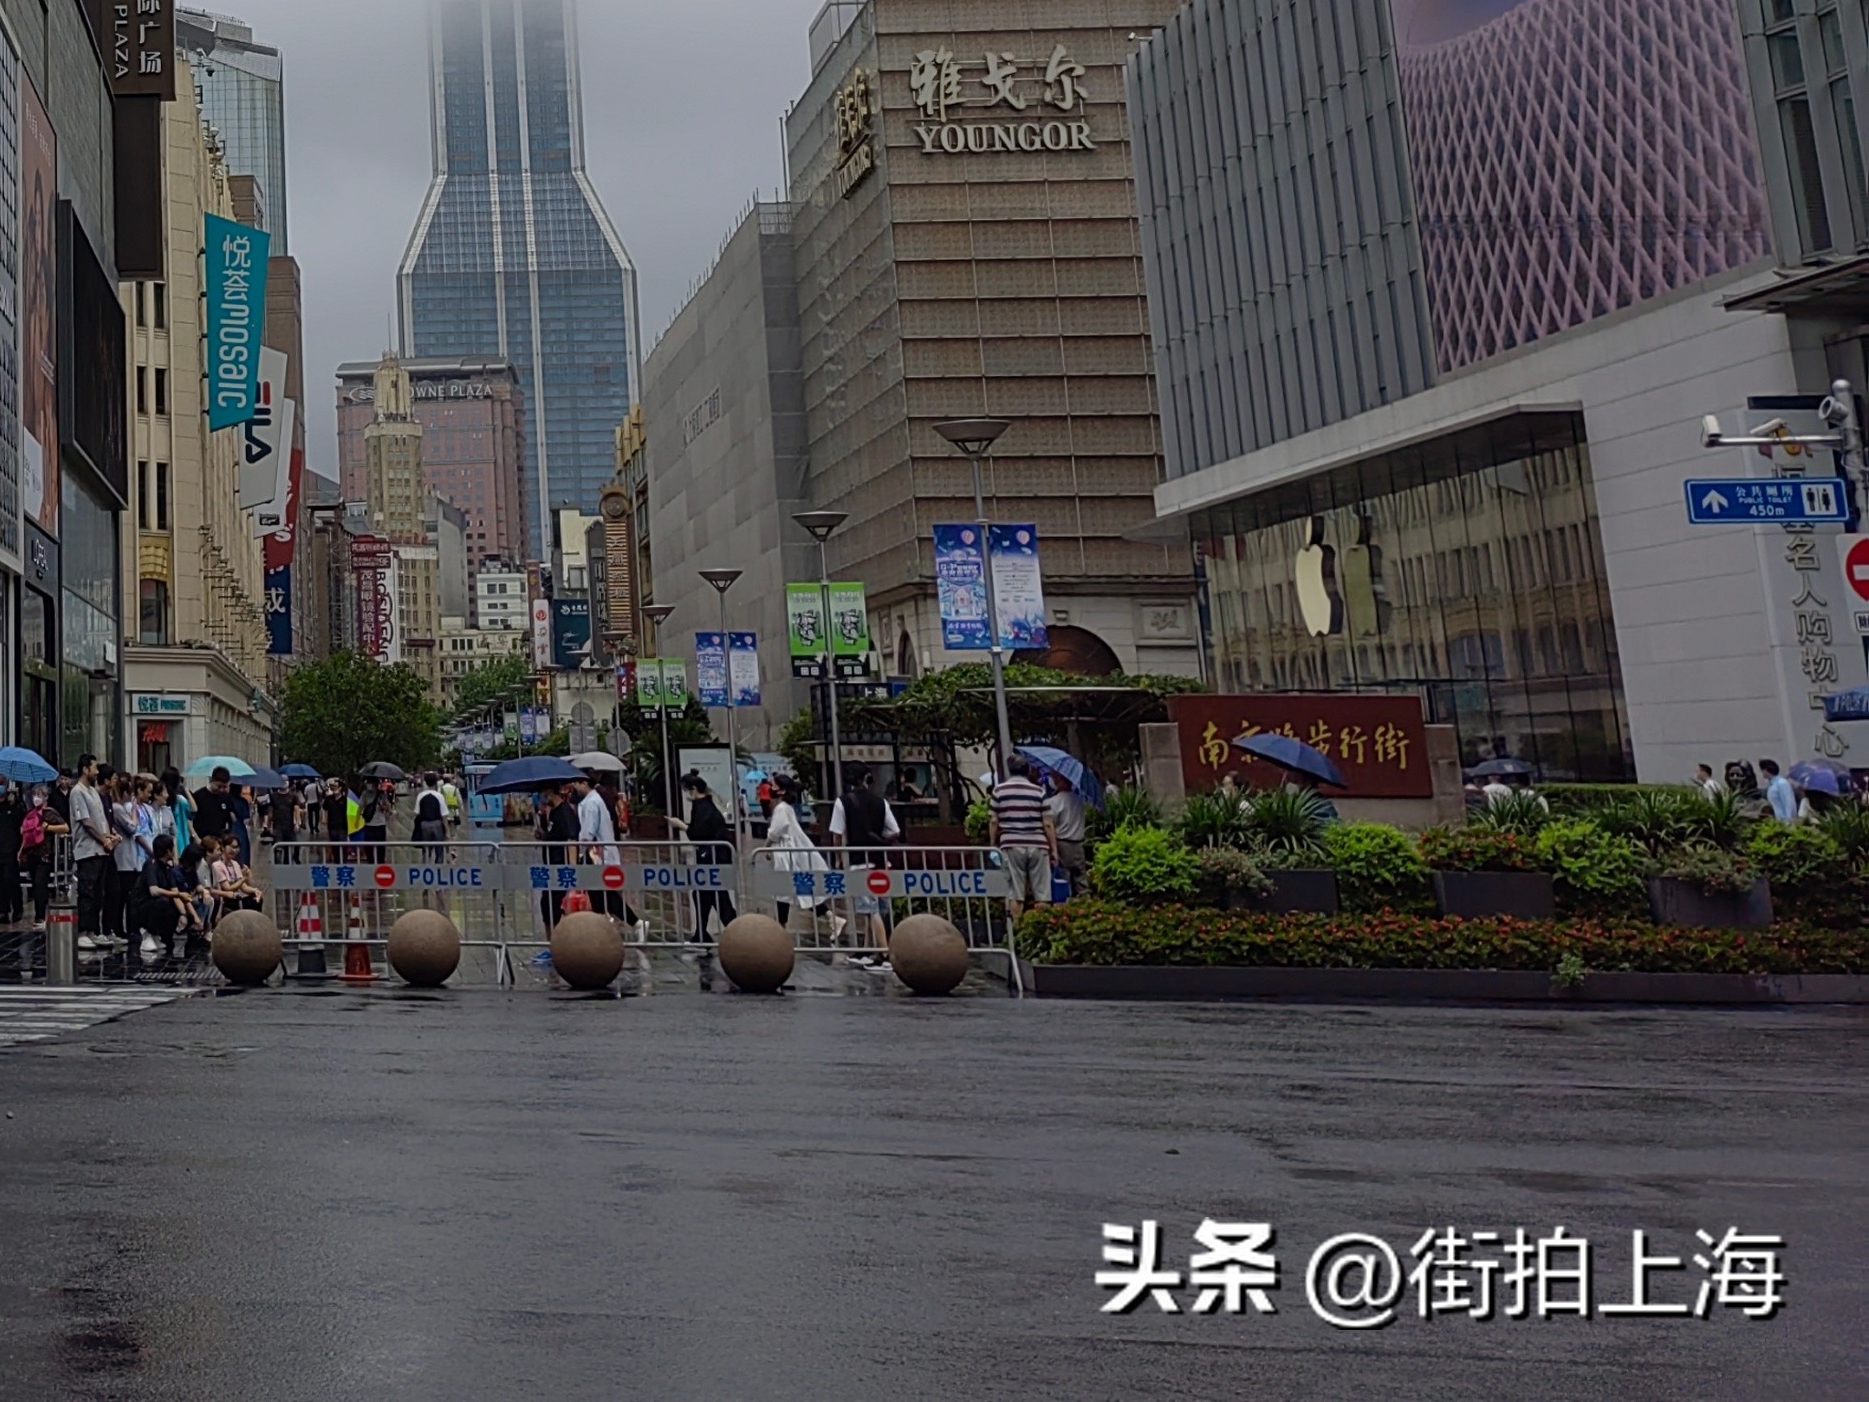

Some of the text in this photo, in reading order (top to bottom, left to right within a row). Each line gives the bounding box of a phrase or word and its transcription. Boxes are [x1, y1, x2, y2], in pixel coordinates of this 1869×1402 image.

[113, 4, 129, 78] PLAZA
[909, 44, 1088, 123] 雅戈尔
[913, 121, 1098, 154] YOUNGOR
[450, 383, 493, 396] PLAZA
[1749, 505, 1785, 516] 450m
[310, 865, 356, 888] 警察
[408, 868, 483, 887] POLICE
[529, 866, 578, 889] 警察
[644, 868, 722, 887] POLICE
[792, 872, 846, 896] 警察
[904, 872, 988, 895] POLICE
